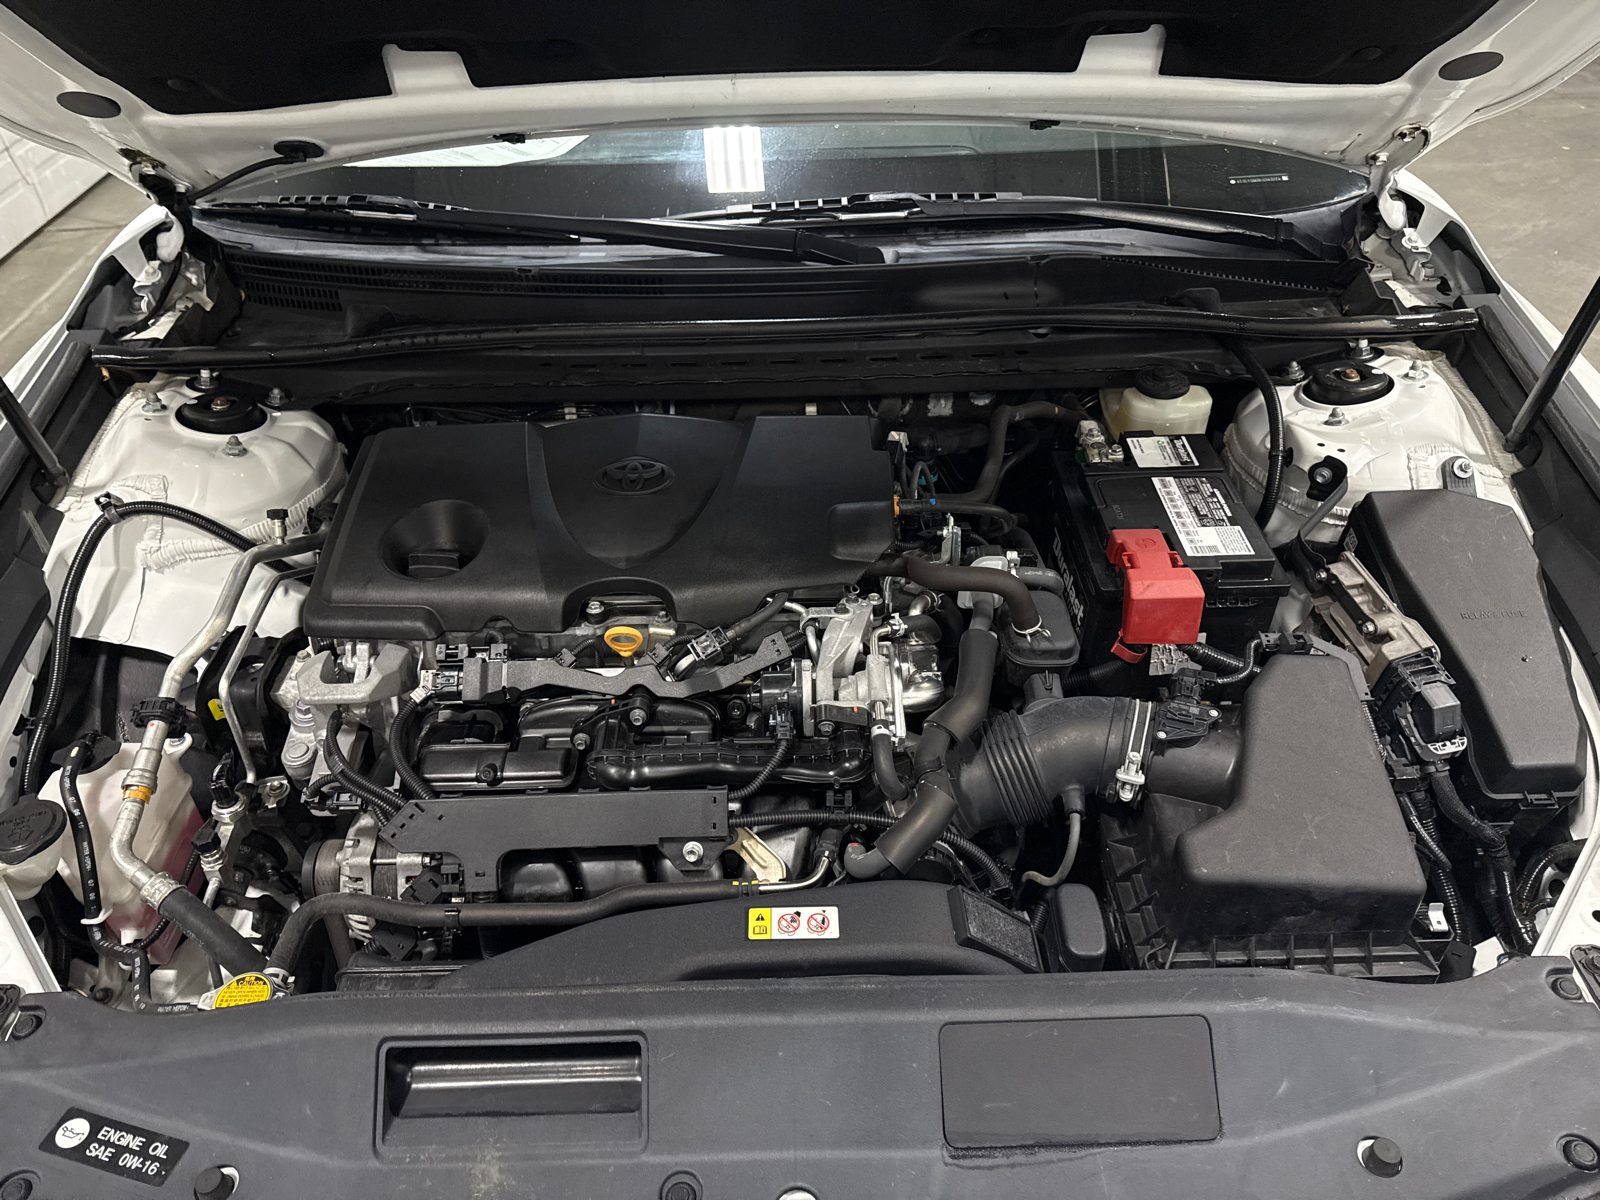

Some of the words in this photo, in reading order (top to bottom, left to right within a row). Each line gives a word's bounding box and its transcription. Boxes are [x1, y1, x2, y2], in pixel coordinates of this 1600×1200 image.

[1053, 527, 1084, 626] Duralast
[1460, 611, 1491, 620] RELAY
[1500, 610, 1528, 619] FUSE
[85, 1142, 116, 1162] SAE
[118, 1153, 160, 1176] 0W-16
[97, 1125, 146, 1151] ENGINE
[149, 1141, 170, 1159] OIL
